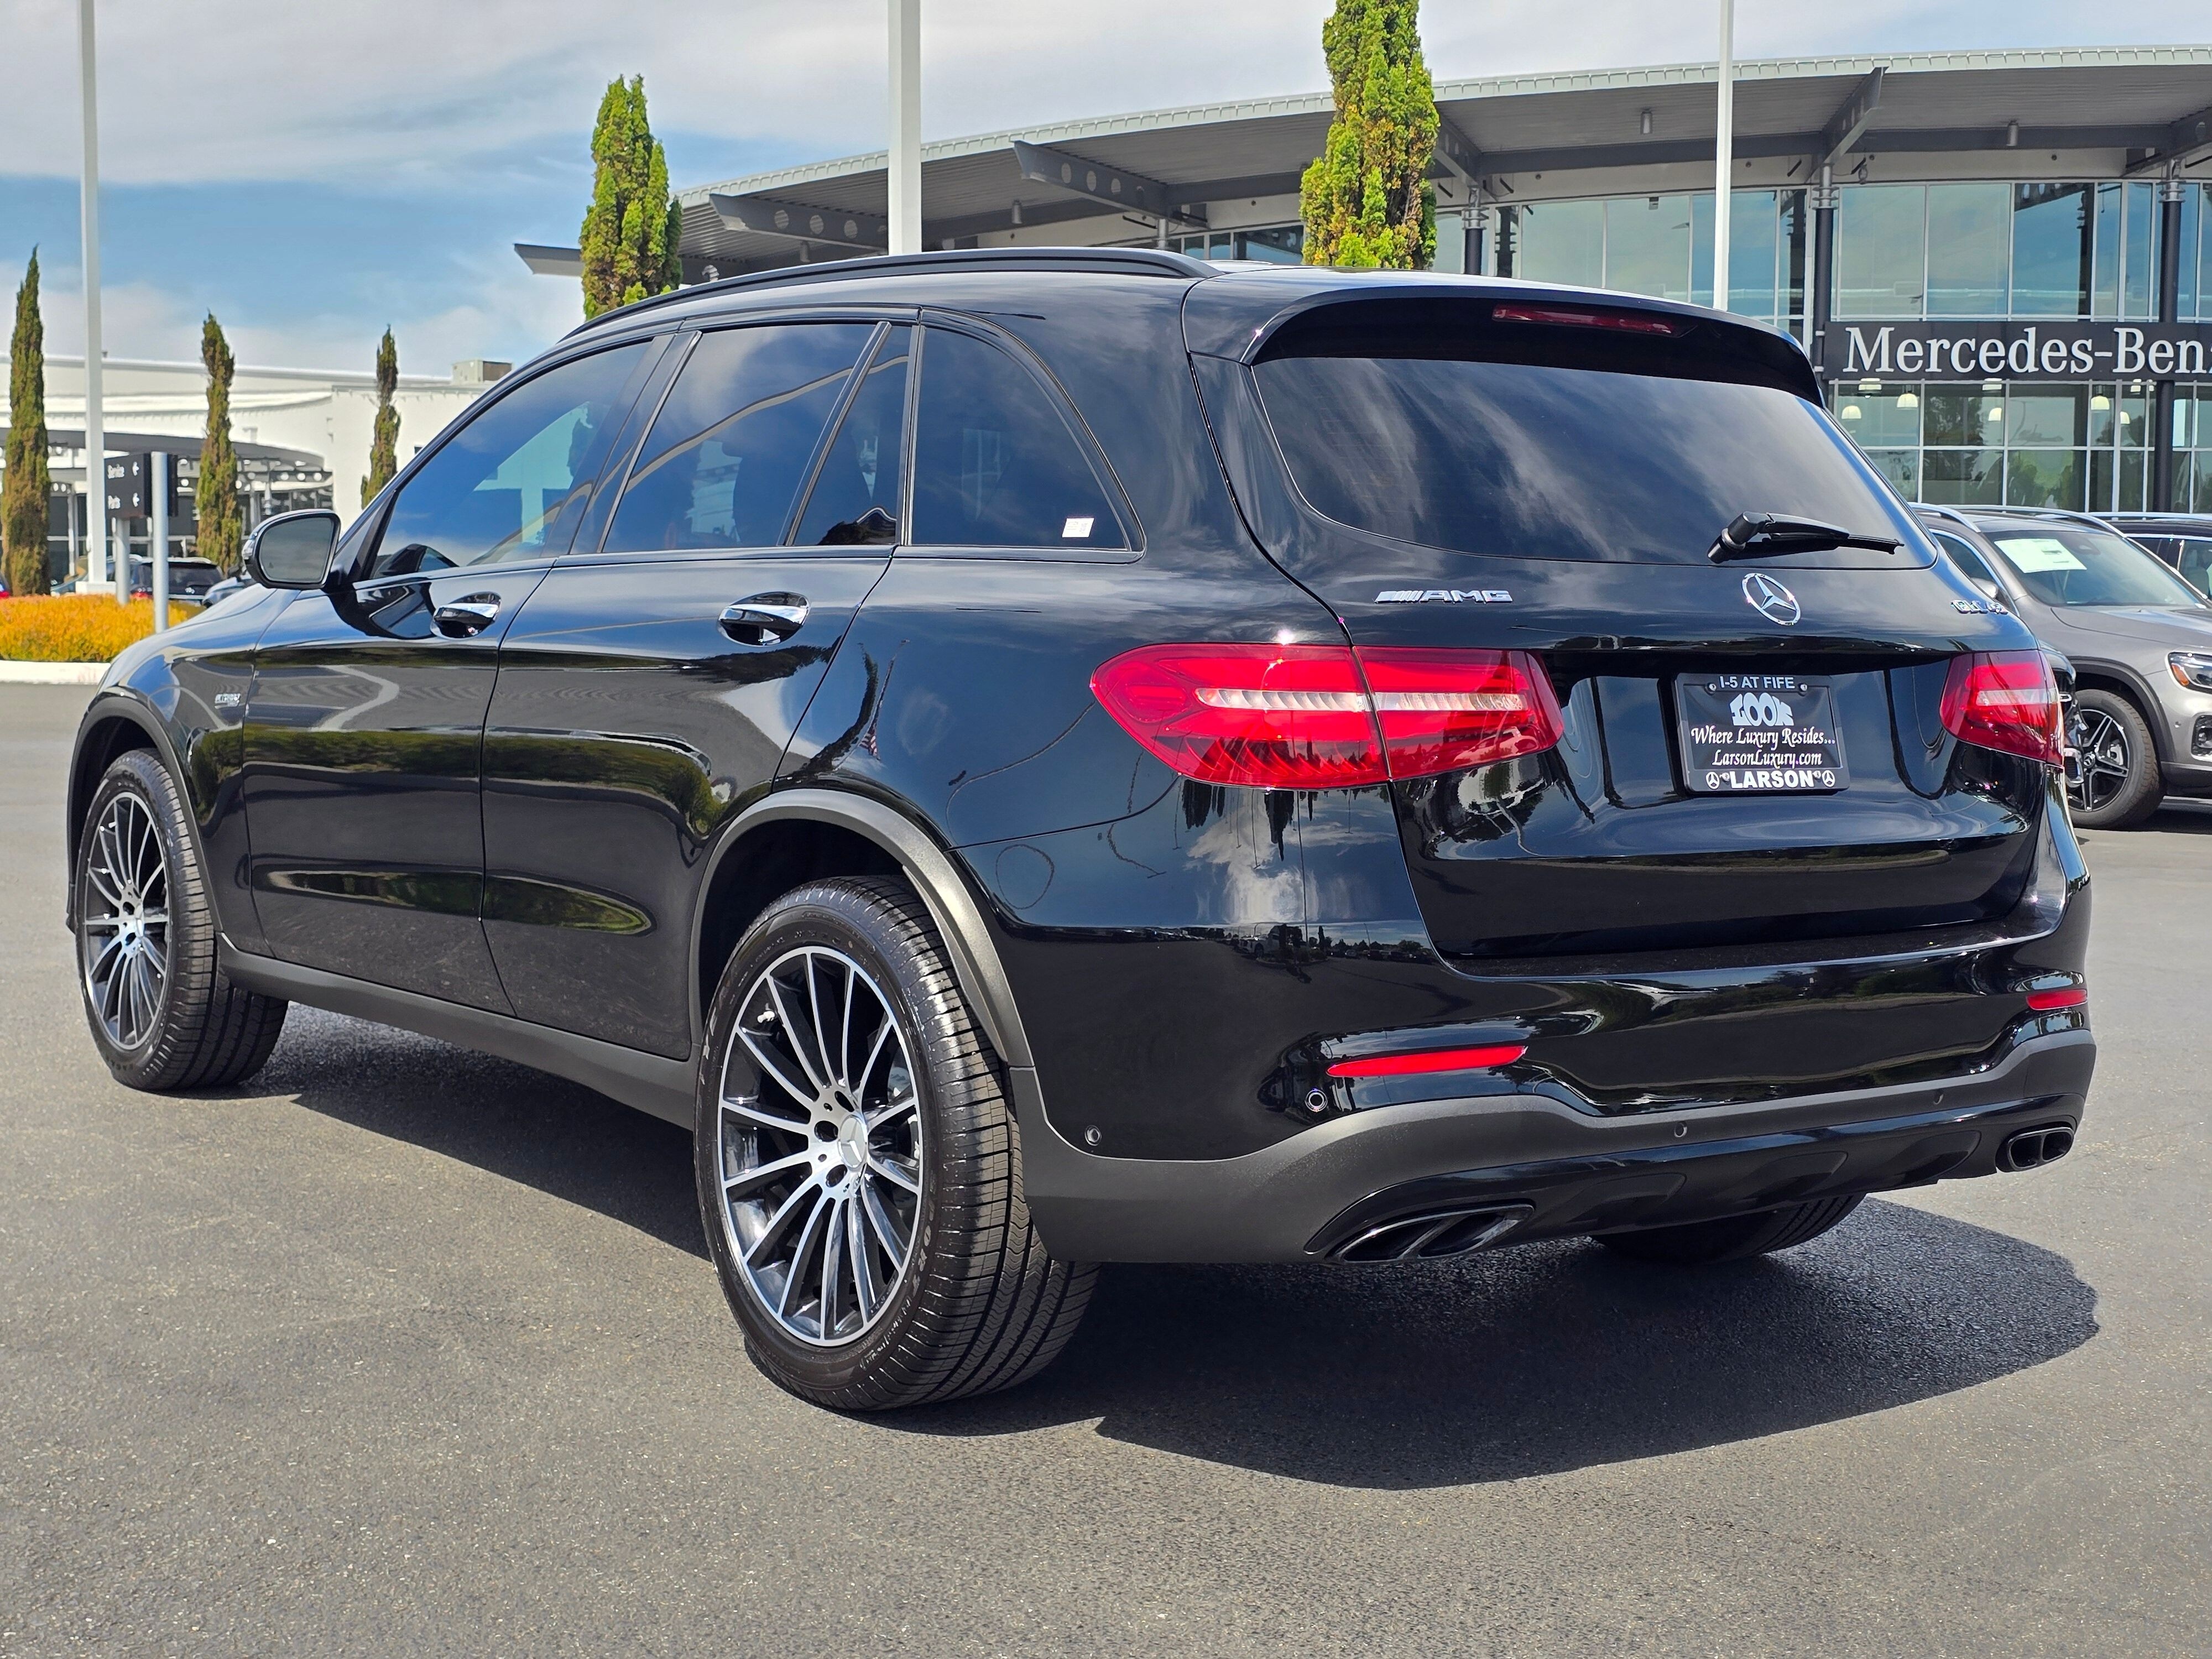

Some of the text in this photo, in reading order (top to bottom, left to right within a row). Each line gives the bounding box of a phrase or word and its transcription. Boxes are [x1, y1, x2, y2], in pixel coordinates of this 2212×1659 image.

[1843, 327, 2212, 374] Mercedes-Ben
[1419, 590, 1513, 604] AMG
[1720, 676, 1796, 689] I-5 AT FIFE
[1691, 725, 1836, 750] Where Luxury Resides...
[1712, 749, 1822, 769] LarsonLuxury.com
[1729, 770, 1814, 789] LARSON
